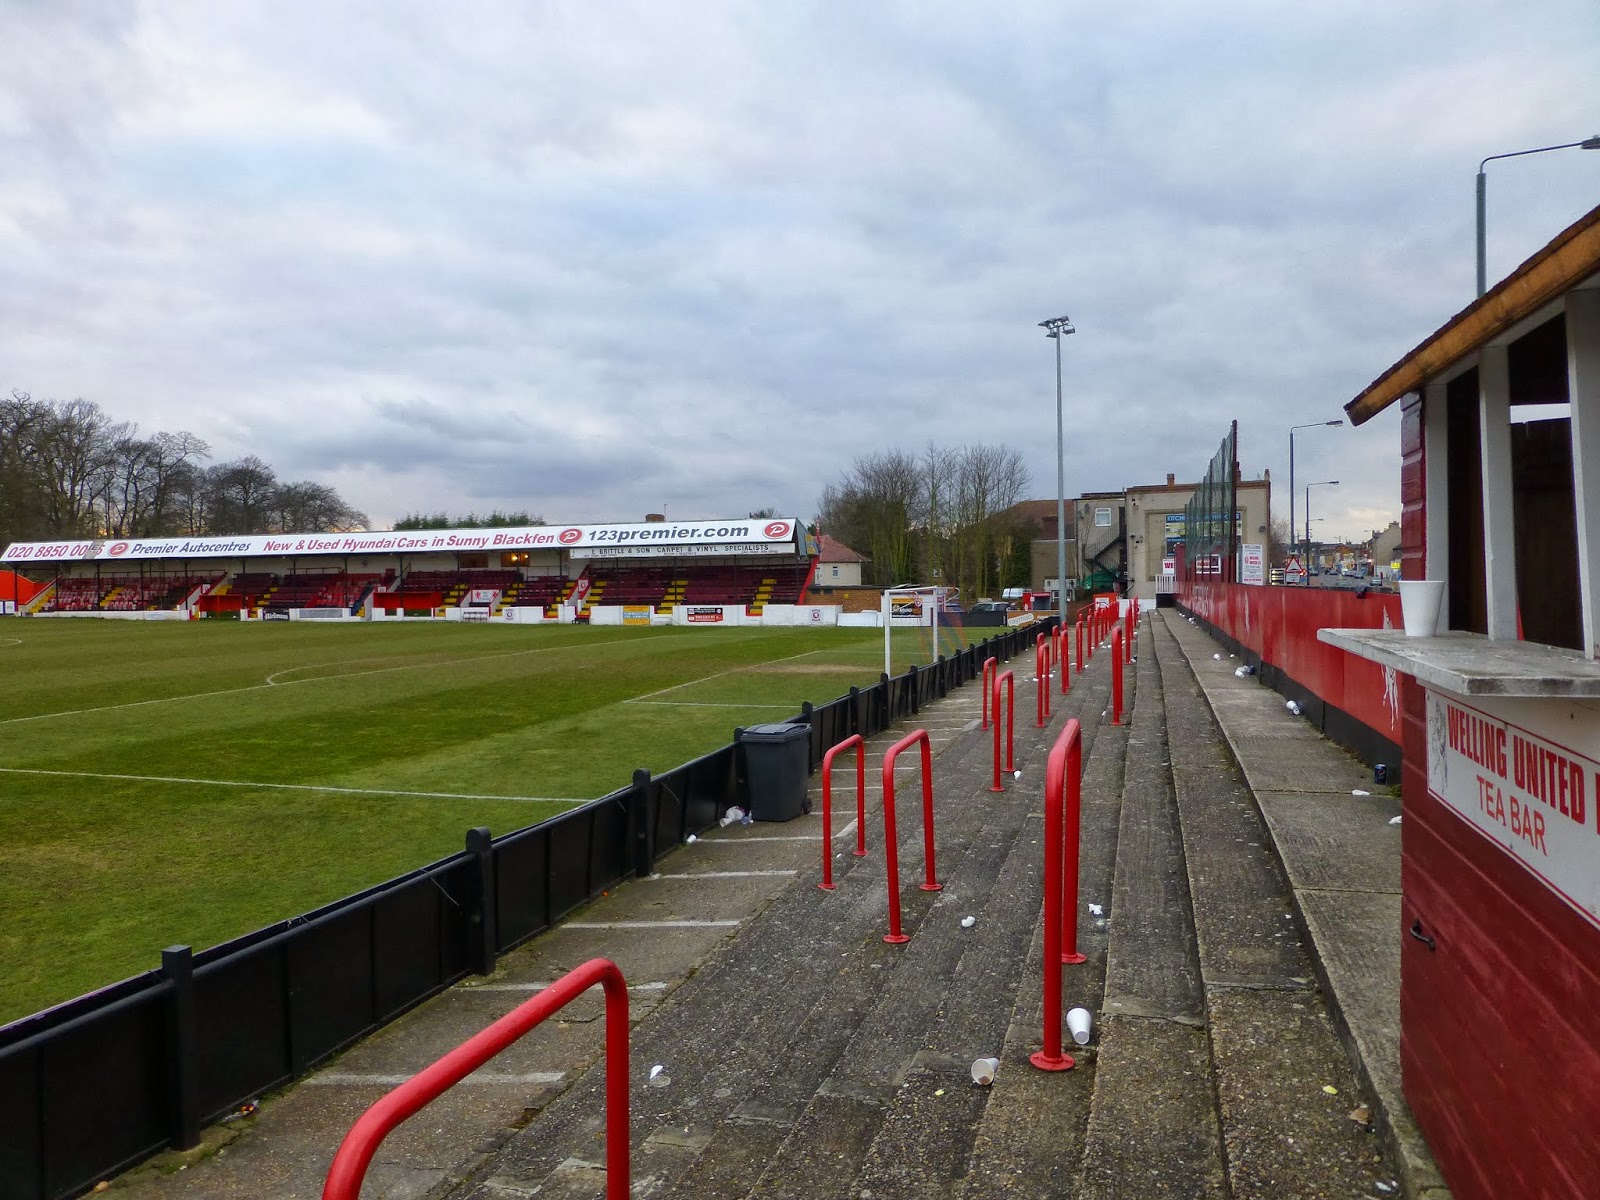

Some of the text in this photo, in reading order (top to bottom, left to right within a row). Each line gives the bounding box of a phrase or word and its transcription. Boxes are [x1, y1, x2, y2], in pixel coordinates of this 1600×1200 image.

[262, 533, 555, 552] New & Used Hyundai Cars in Sunny Blackfen
[588, 526, 750, 544] 123premier.com
[7, 546, 34, 558] 020
[34, 545, 69, 558] 8850
[130, 541, 252, 555] Premier Autocentres
[599, 547, 626, 555] BRITTLE
[724, 544, 769, 552] SPECIALISTS
[1446, 703, 1508, 781] WELLING
[1513, 734, 1586, 826] UNITED
[1476, 773, 1507, 827] TEA
[1509, 794, 1549, 857] BAR
